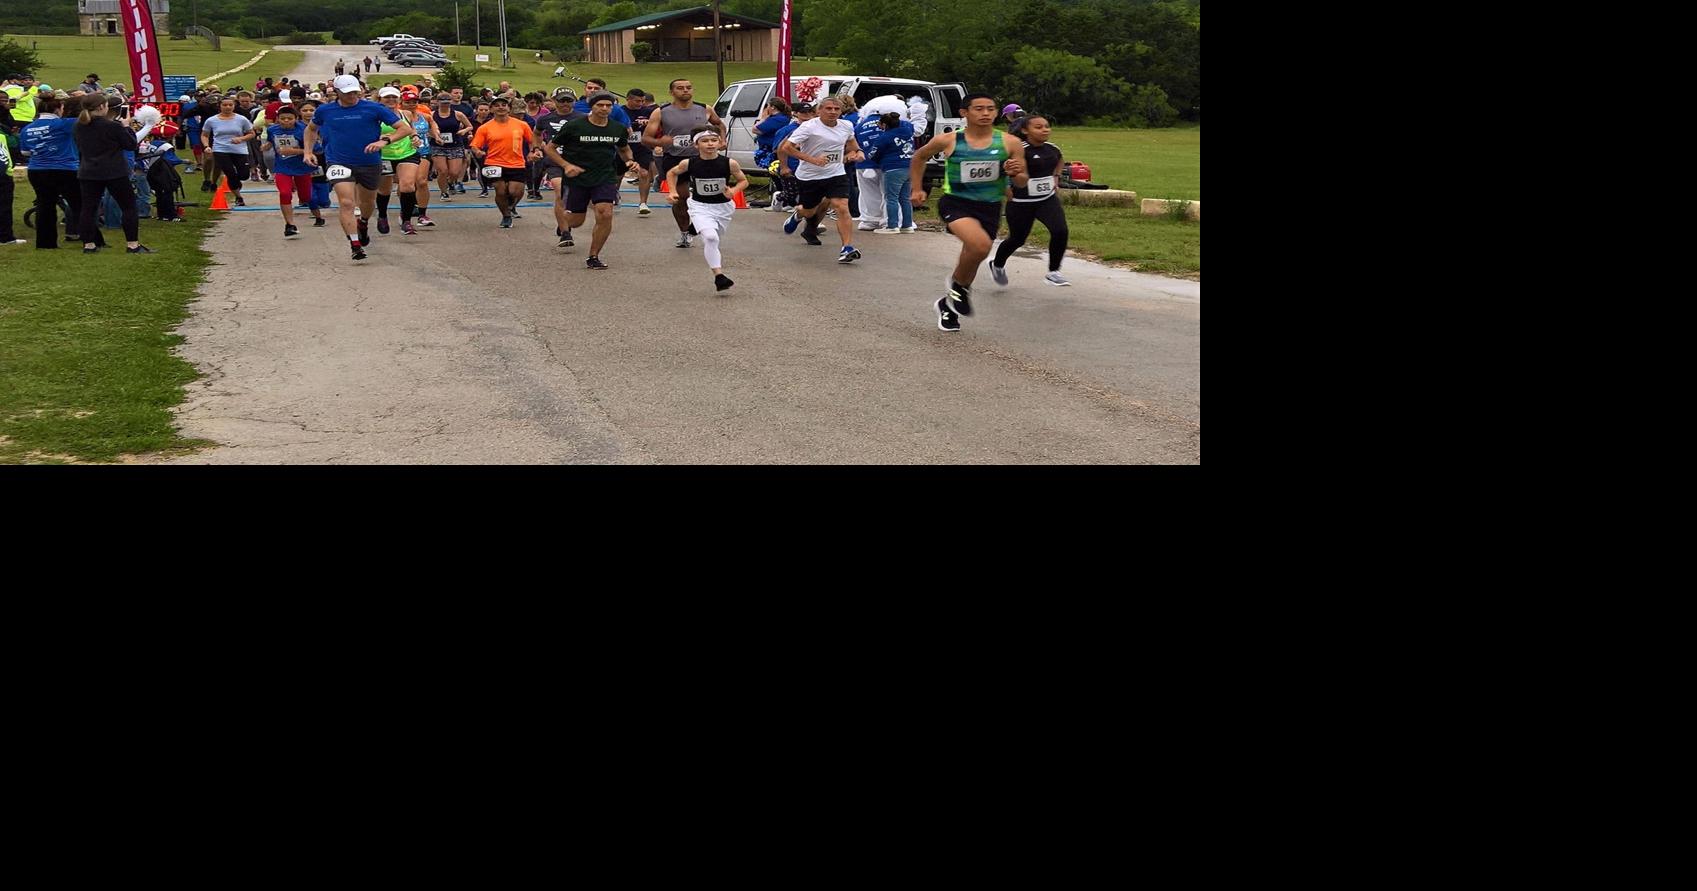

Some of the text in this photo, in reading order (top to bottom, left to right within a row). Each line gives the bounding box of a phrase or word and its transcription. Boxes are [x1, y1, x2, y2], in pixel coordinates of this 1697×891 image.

[331, 169, 345, 177] 641
[970, 167, 992, 179] 606
[703, 183, 720, 193] 613
